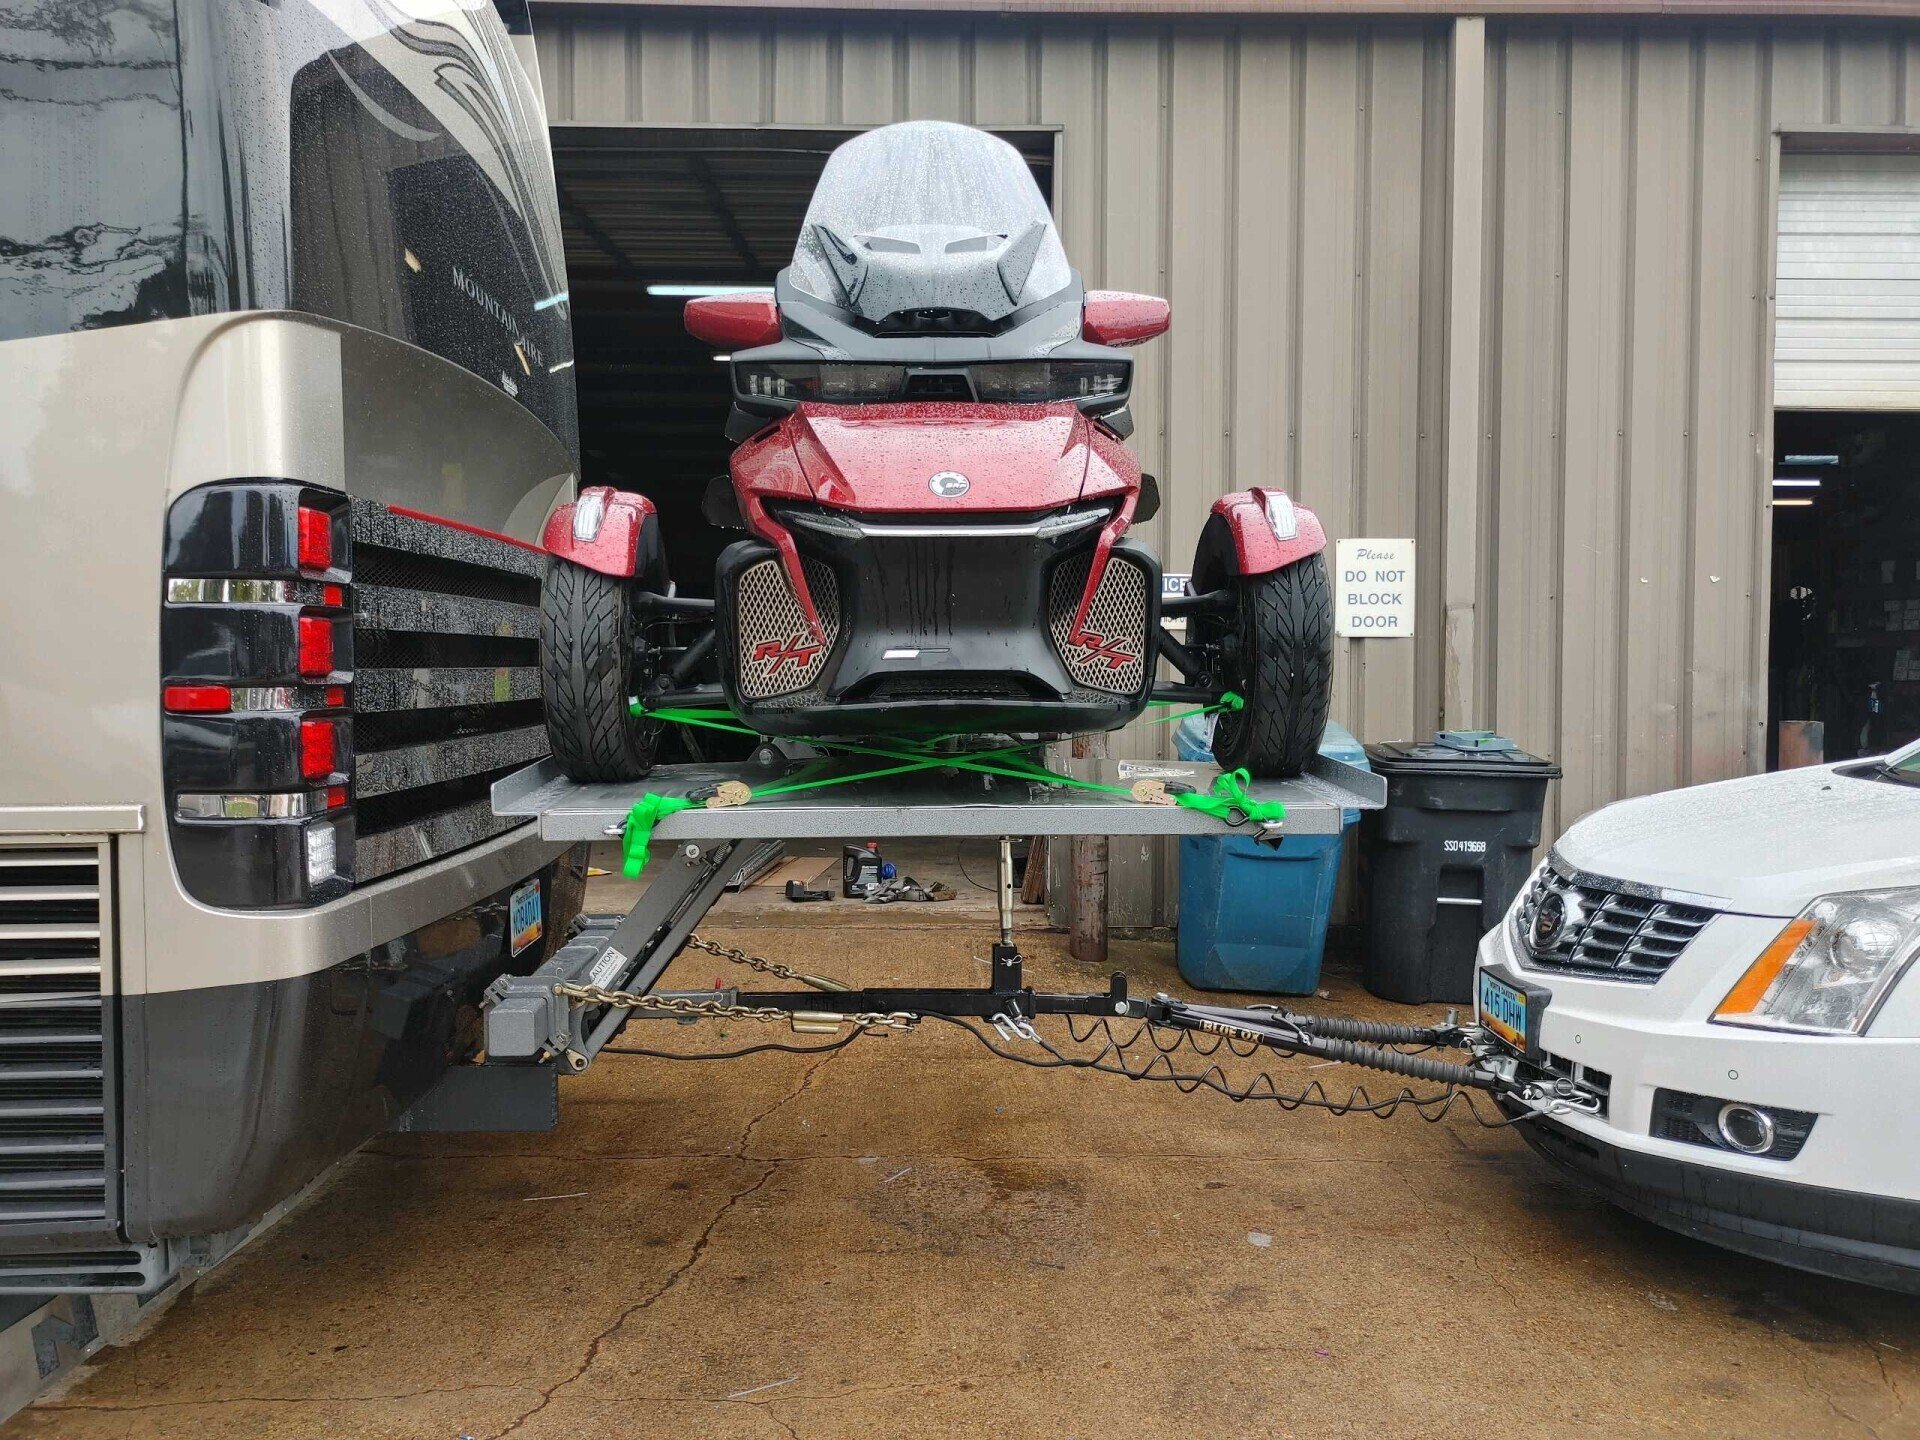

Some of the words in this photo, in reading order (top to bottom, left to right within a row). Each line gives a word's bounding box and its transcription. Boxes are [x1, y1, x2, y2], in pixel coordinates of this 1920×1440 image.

[453, 266, 519, 339] MOUNTAIN
[1356, 548, 1396, 561] Please
[1345, 570, 1367, 583] DO
[1375, 570, 1405, 583] NOT
[1347, 593, 1402, 605] BLOCK
[1351, 615, 1398, 628] DOOR
[752, 634, 823, 676] R/T
[1068, 631, 1136, 670] R/T
[1484, 987, 1500, 1018] 415
[1202, 1021, 1237, 1038] BLUE
[1240, 1029, 1260, 1043] OX
